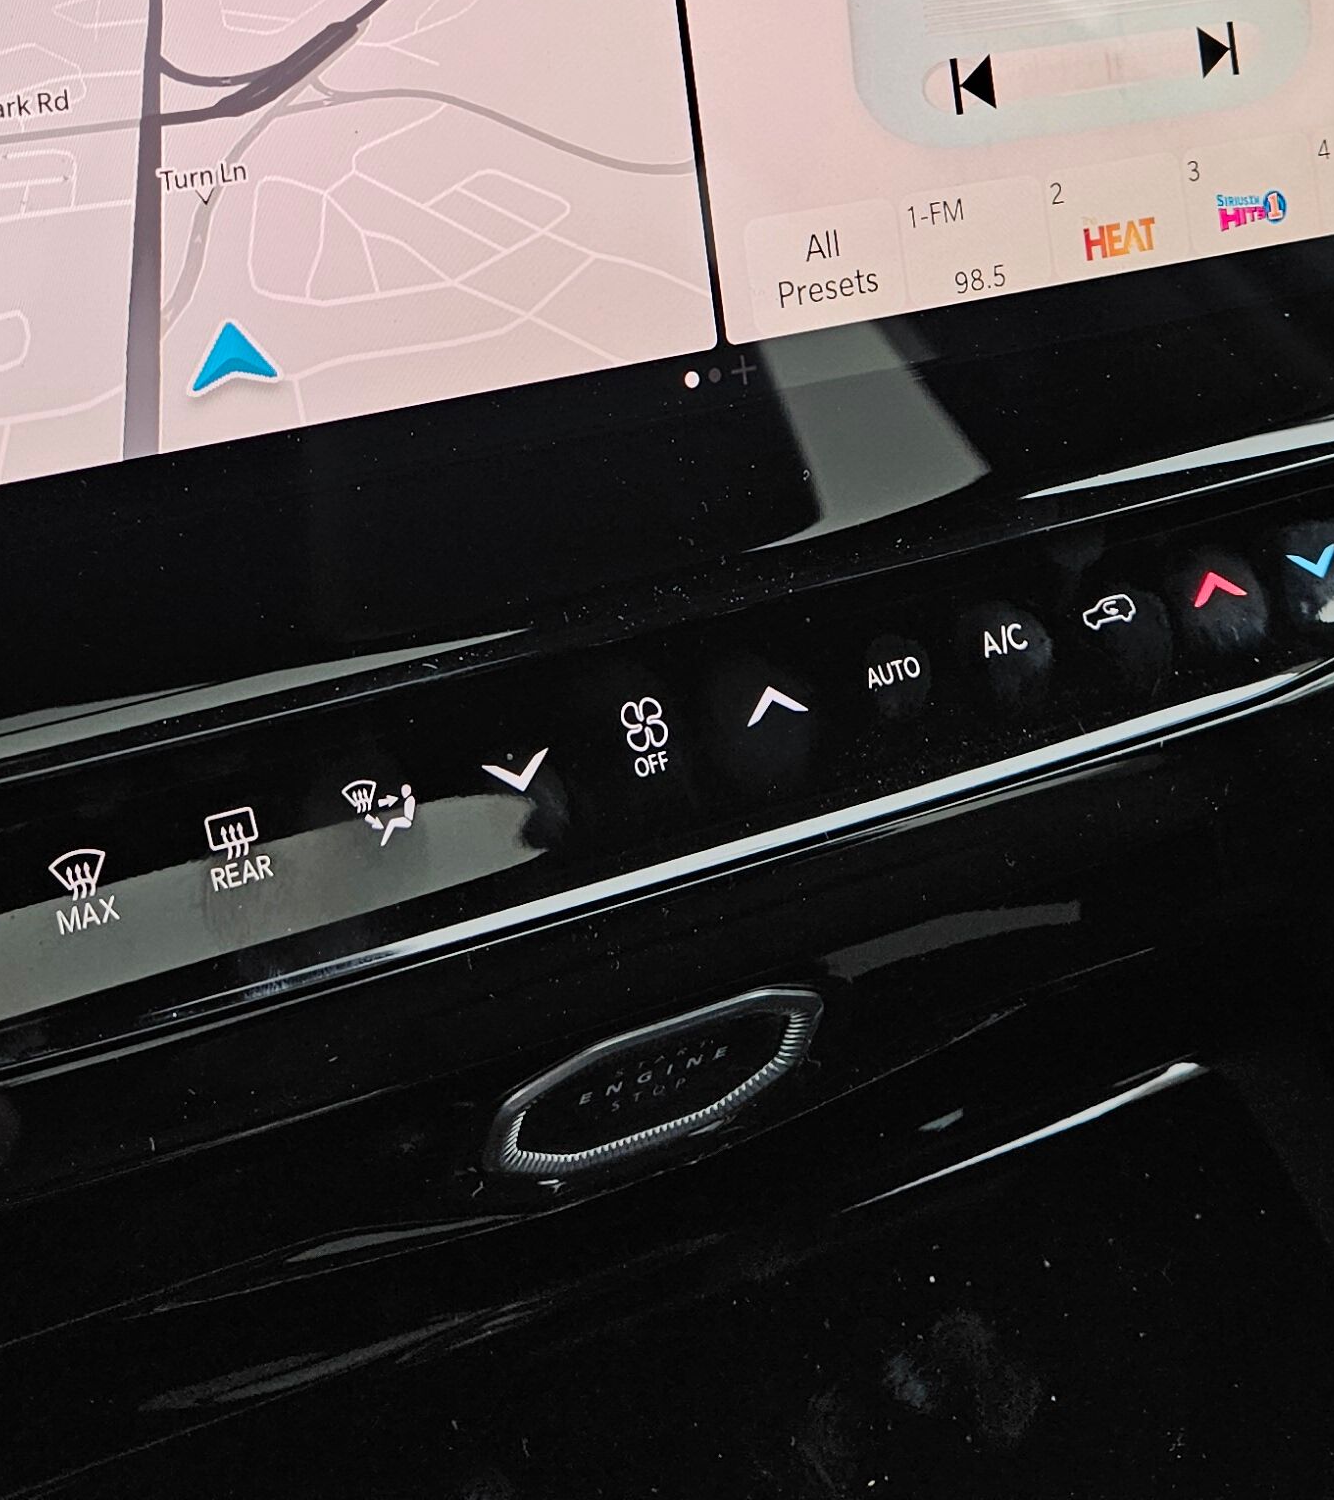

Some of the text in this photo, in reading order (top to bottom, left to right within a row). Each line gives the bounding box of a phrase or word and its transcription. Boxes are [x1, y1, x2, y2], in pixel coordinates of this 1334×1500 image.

[36, 90, 69, 114] Rd
[1318, 139, 1330, 160] 4
[160, 163, 247, 191] Turn Ln
[1187, 161, 1200, 182] 3
[1050, 182, 1065, 205] 2
[1267, 193, 1282, 218] 1
[908, 198, 965, 228] 1-FM
[806, 229, 840, 262] All
[1083, 217, 1155, 261] HEAT
[779, 269, 879, 308] Presets
[955, 264, 1006, 294] 98.5
[983, 623, 1028, 658] A/C
[867, 656, 921, 690] AUTO
[634, 750, 670, 778] OFF
[210, 855, 274, 891] REAR
[56, 895, 121, 936] MAX
[579, 1046, 728, 1106] ENGINE
[611, 1077, 687, 1112] STOP
